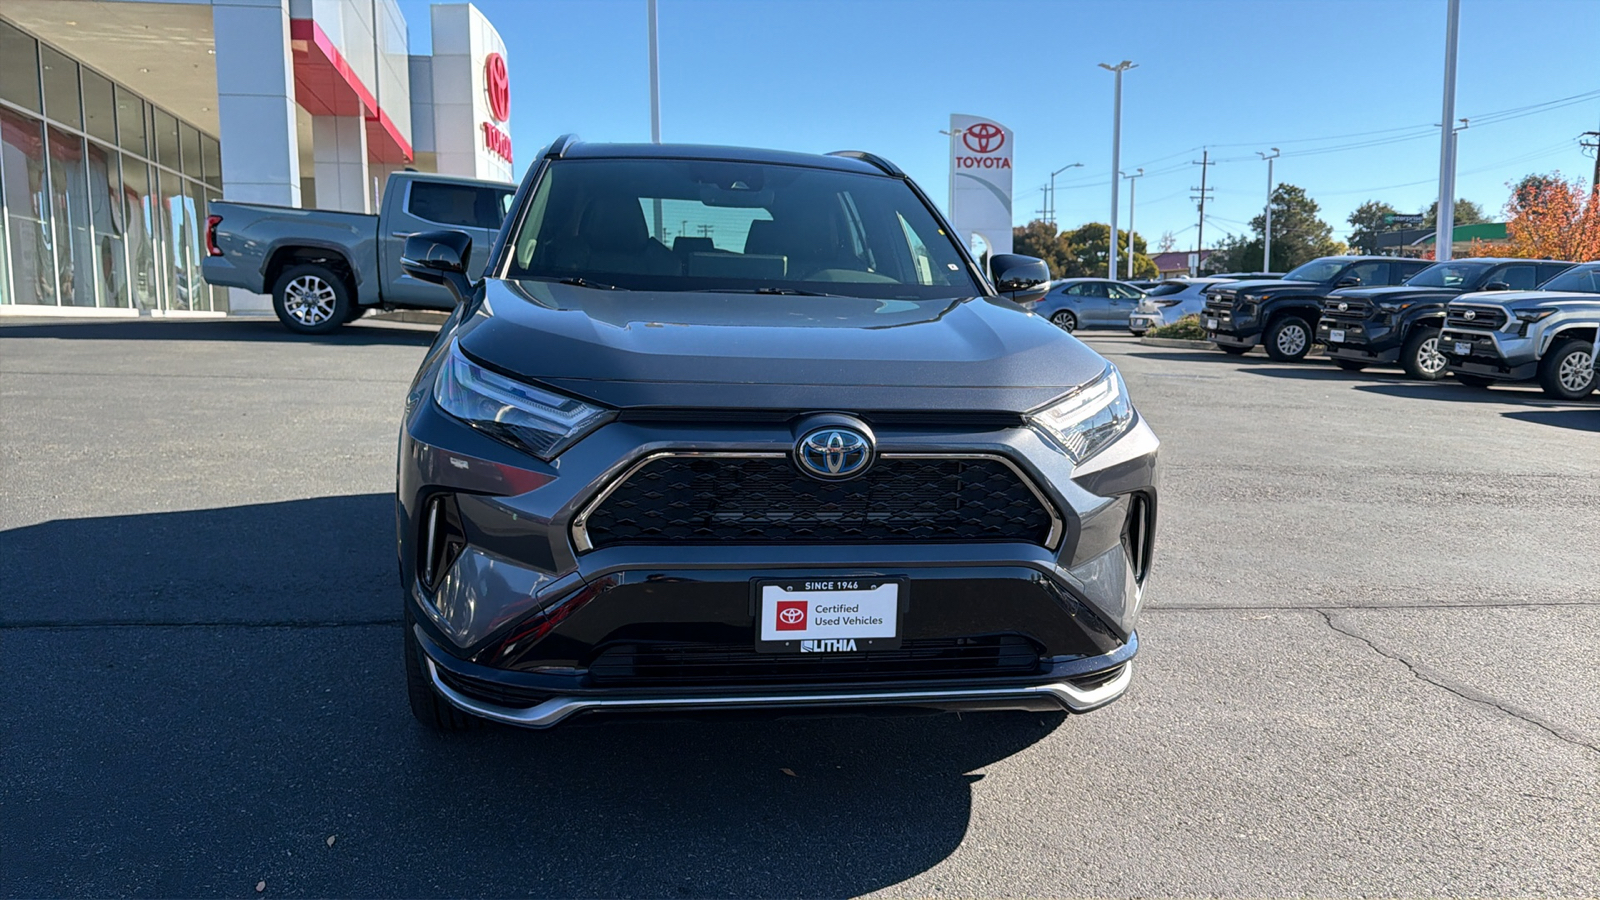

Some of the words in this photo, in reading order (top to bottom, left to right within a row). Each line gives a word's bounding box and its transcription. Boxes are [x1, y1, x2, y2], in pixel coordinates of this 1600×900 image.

[956, 156, 1012, 169] TOYOTA
[805, 582, 834, 590] SINCE
[837, 581, 859, 590] 1946
[815, 604, 859, 613] Certified
[815, 617, 840, 626] Used
[842, 616, 883, 625] Vehicles
[813, 639, 857, 652] LITHIA
